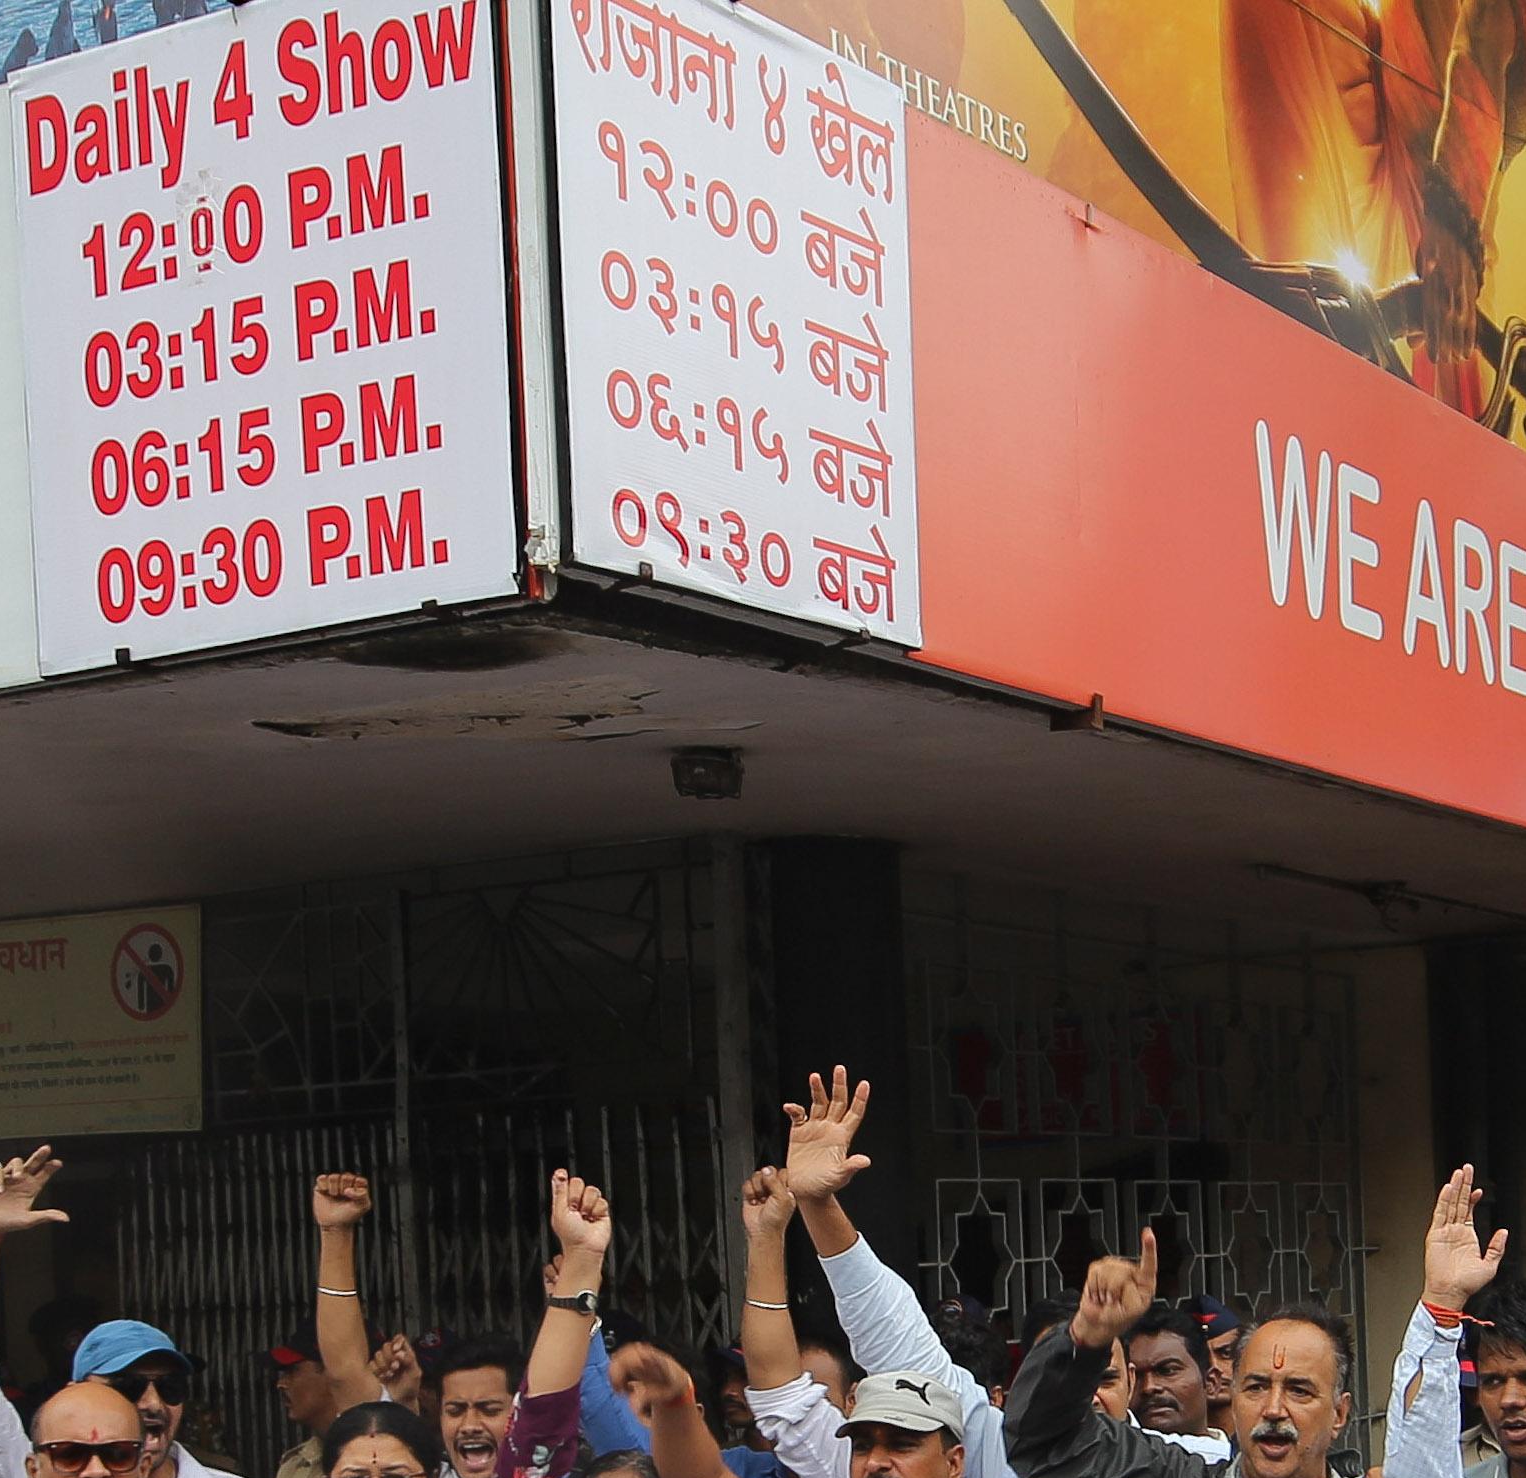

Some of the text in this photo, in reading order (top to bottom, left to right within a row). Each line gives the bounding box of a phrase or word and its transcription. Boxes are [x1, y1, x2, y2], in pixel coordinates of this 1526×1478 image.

[25, 0, 474, 196] Daily 4 Show
[758, 54, 787, 155] ४
[805, 62, 895, 204] खेल
[876, 51, 1028, 163] THEATRES
[82, 143, 431, 298] 12:00 P.M.
[801, 207, 885, 308] बजे
[84, 260, 437, 406] 03:15 P.M.
[806, 313, 890, 413] बजे
[91, 374, 443, 516] 06:15 P.M.
[809, 420, 894, 520] बजे
[97, 489, 448, 624] 09:30 P.M.
[812, 525, 897, 624] बजे
[1255, 419, 1383, 641] WE
